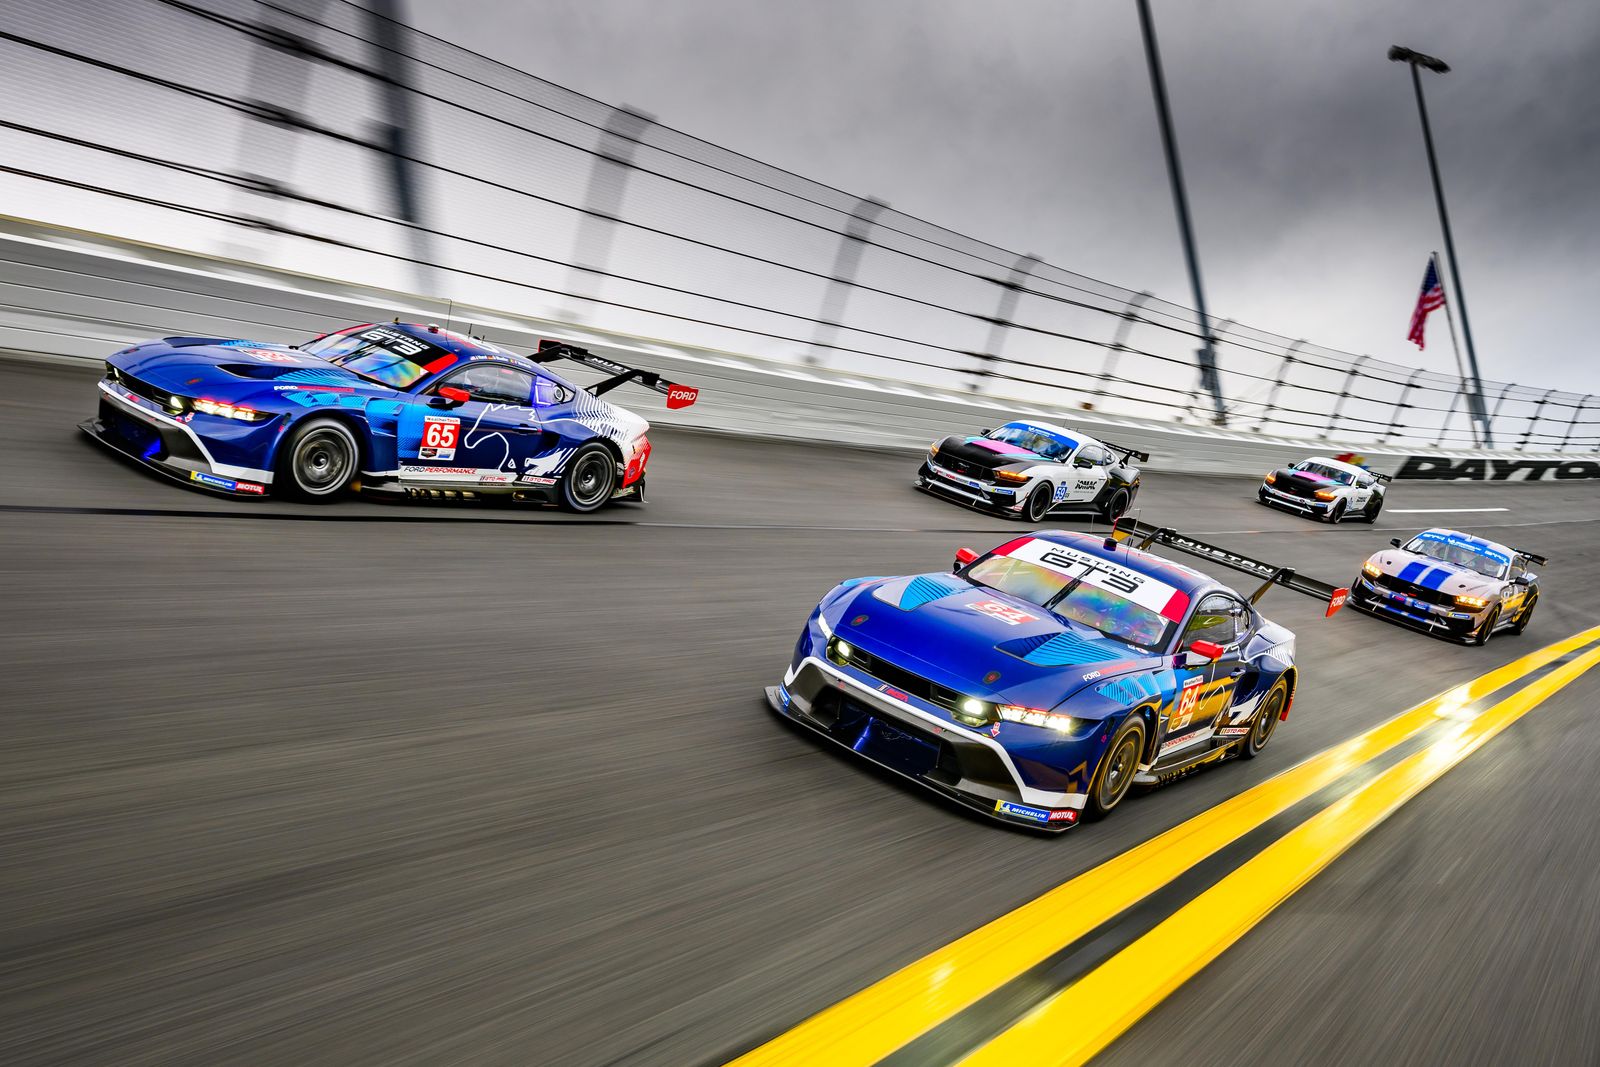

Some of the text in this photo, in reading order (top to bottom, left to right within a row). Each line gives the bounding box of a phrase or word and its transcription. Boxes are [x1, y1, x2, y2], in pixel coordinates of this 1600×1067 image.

[360, 330, 423, 356] GT3
[375, 328, 430, 351] MUSTANG
[669, 390, 697, 401] FORD
[427, 423, 455, 448] 65
[424, 467, 477, 475] PERFORMANCE
[1395, 455, 1600, 481] DAYTO
[237, 481, 263, 493] MOTUL
[1051, 547, 1145, 584] MUSTANG
[1176, 538, 1276, 574] MUSTAN
[1040, 552, 1139, 593] GT3
[1330, 595, 1346, 608] FORD
[983, 603, 1026, 621] 64
[1082, 670, 1101, 682] FORD
[1179, 686, 1200, 716] 64
[1011, 807, 1047, 819] MICHELIN
[1050, 811, 1074, 820] MOTUL
